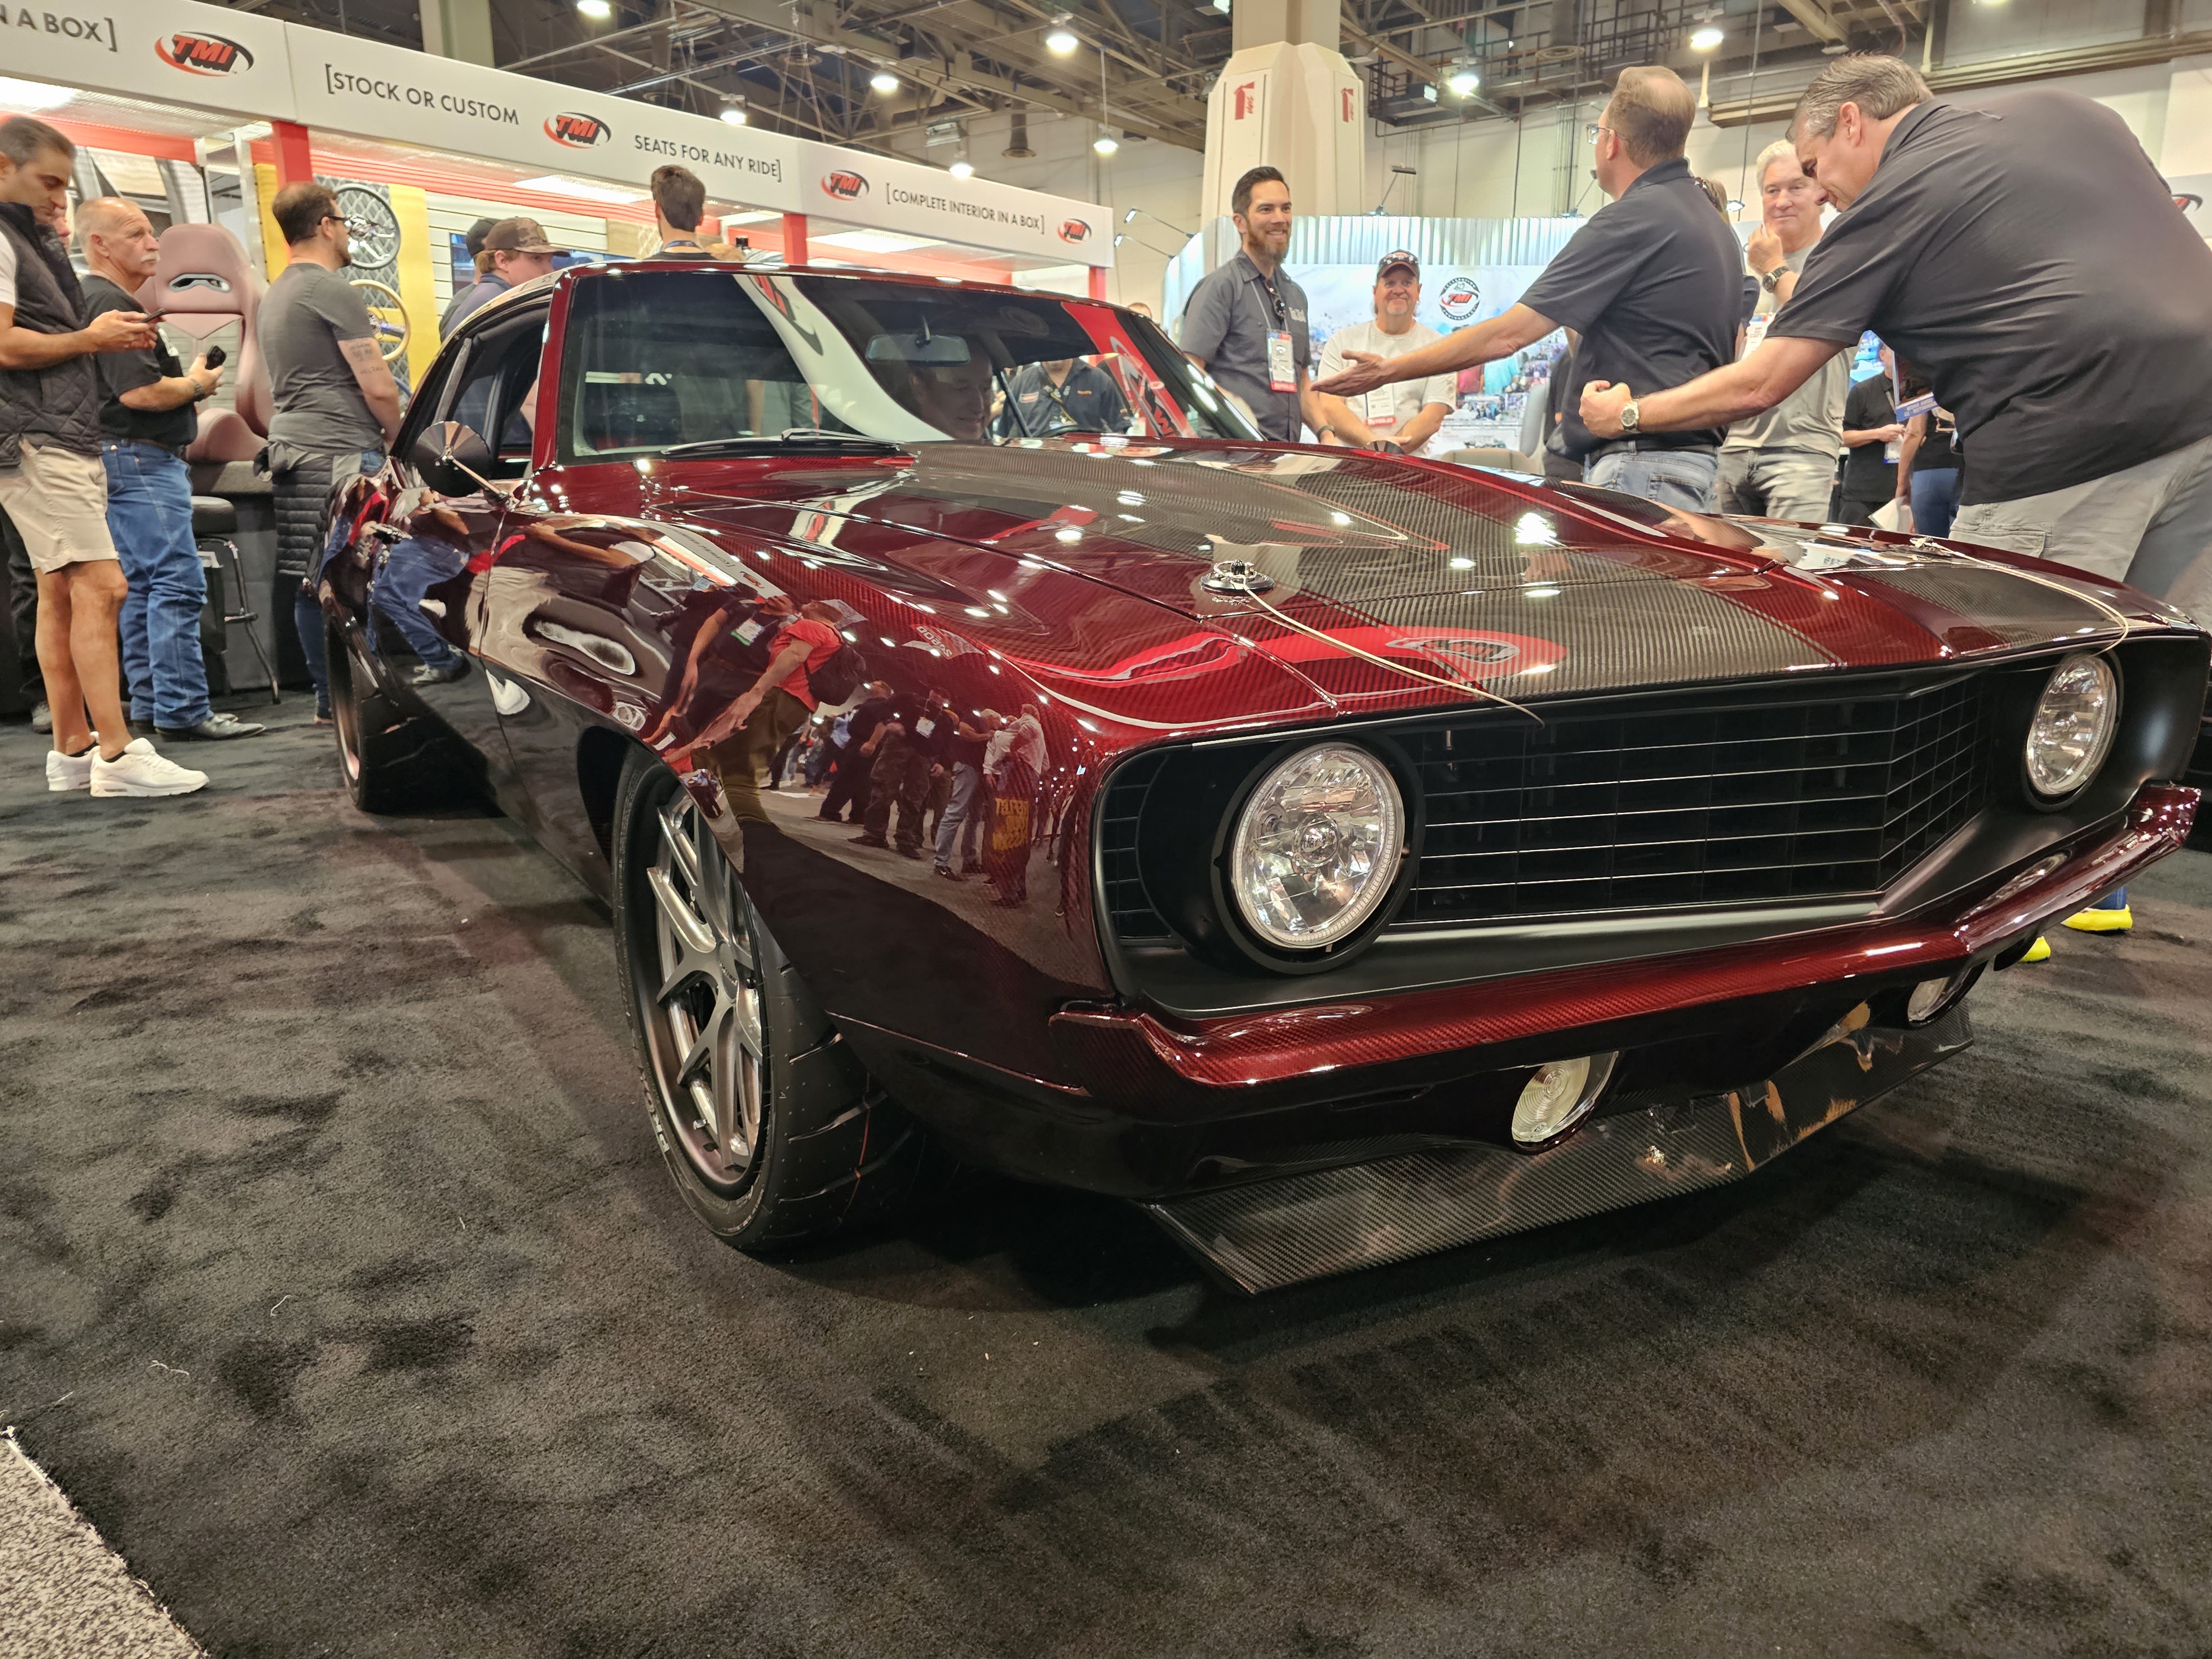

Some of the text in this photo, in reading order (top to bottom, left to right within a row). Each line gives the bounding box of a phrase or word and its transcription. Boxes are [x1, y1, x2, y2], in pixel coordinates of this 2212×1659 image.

[17, 8, 37, 30] A
[171, 34, 238, 72] TMI
[406, 87, 435, 108] OR
[441, 95, 519, 125] CUSTOM
[556, 115, 599, 144] TMI
[635, 134, 677, 156] SEATS
[681, 144, 710, 164] FOR
[714, 152, 744, 170] ANY
[831, 173, 862, 197] TMI
[949, 200, 995, 221] INTERIOR
[998, 211, 1009, 225] IN
[1011, 213, 1018, 226] A
[1064, 221, 1086, 241] TMI
